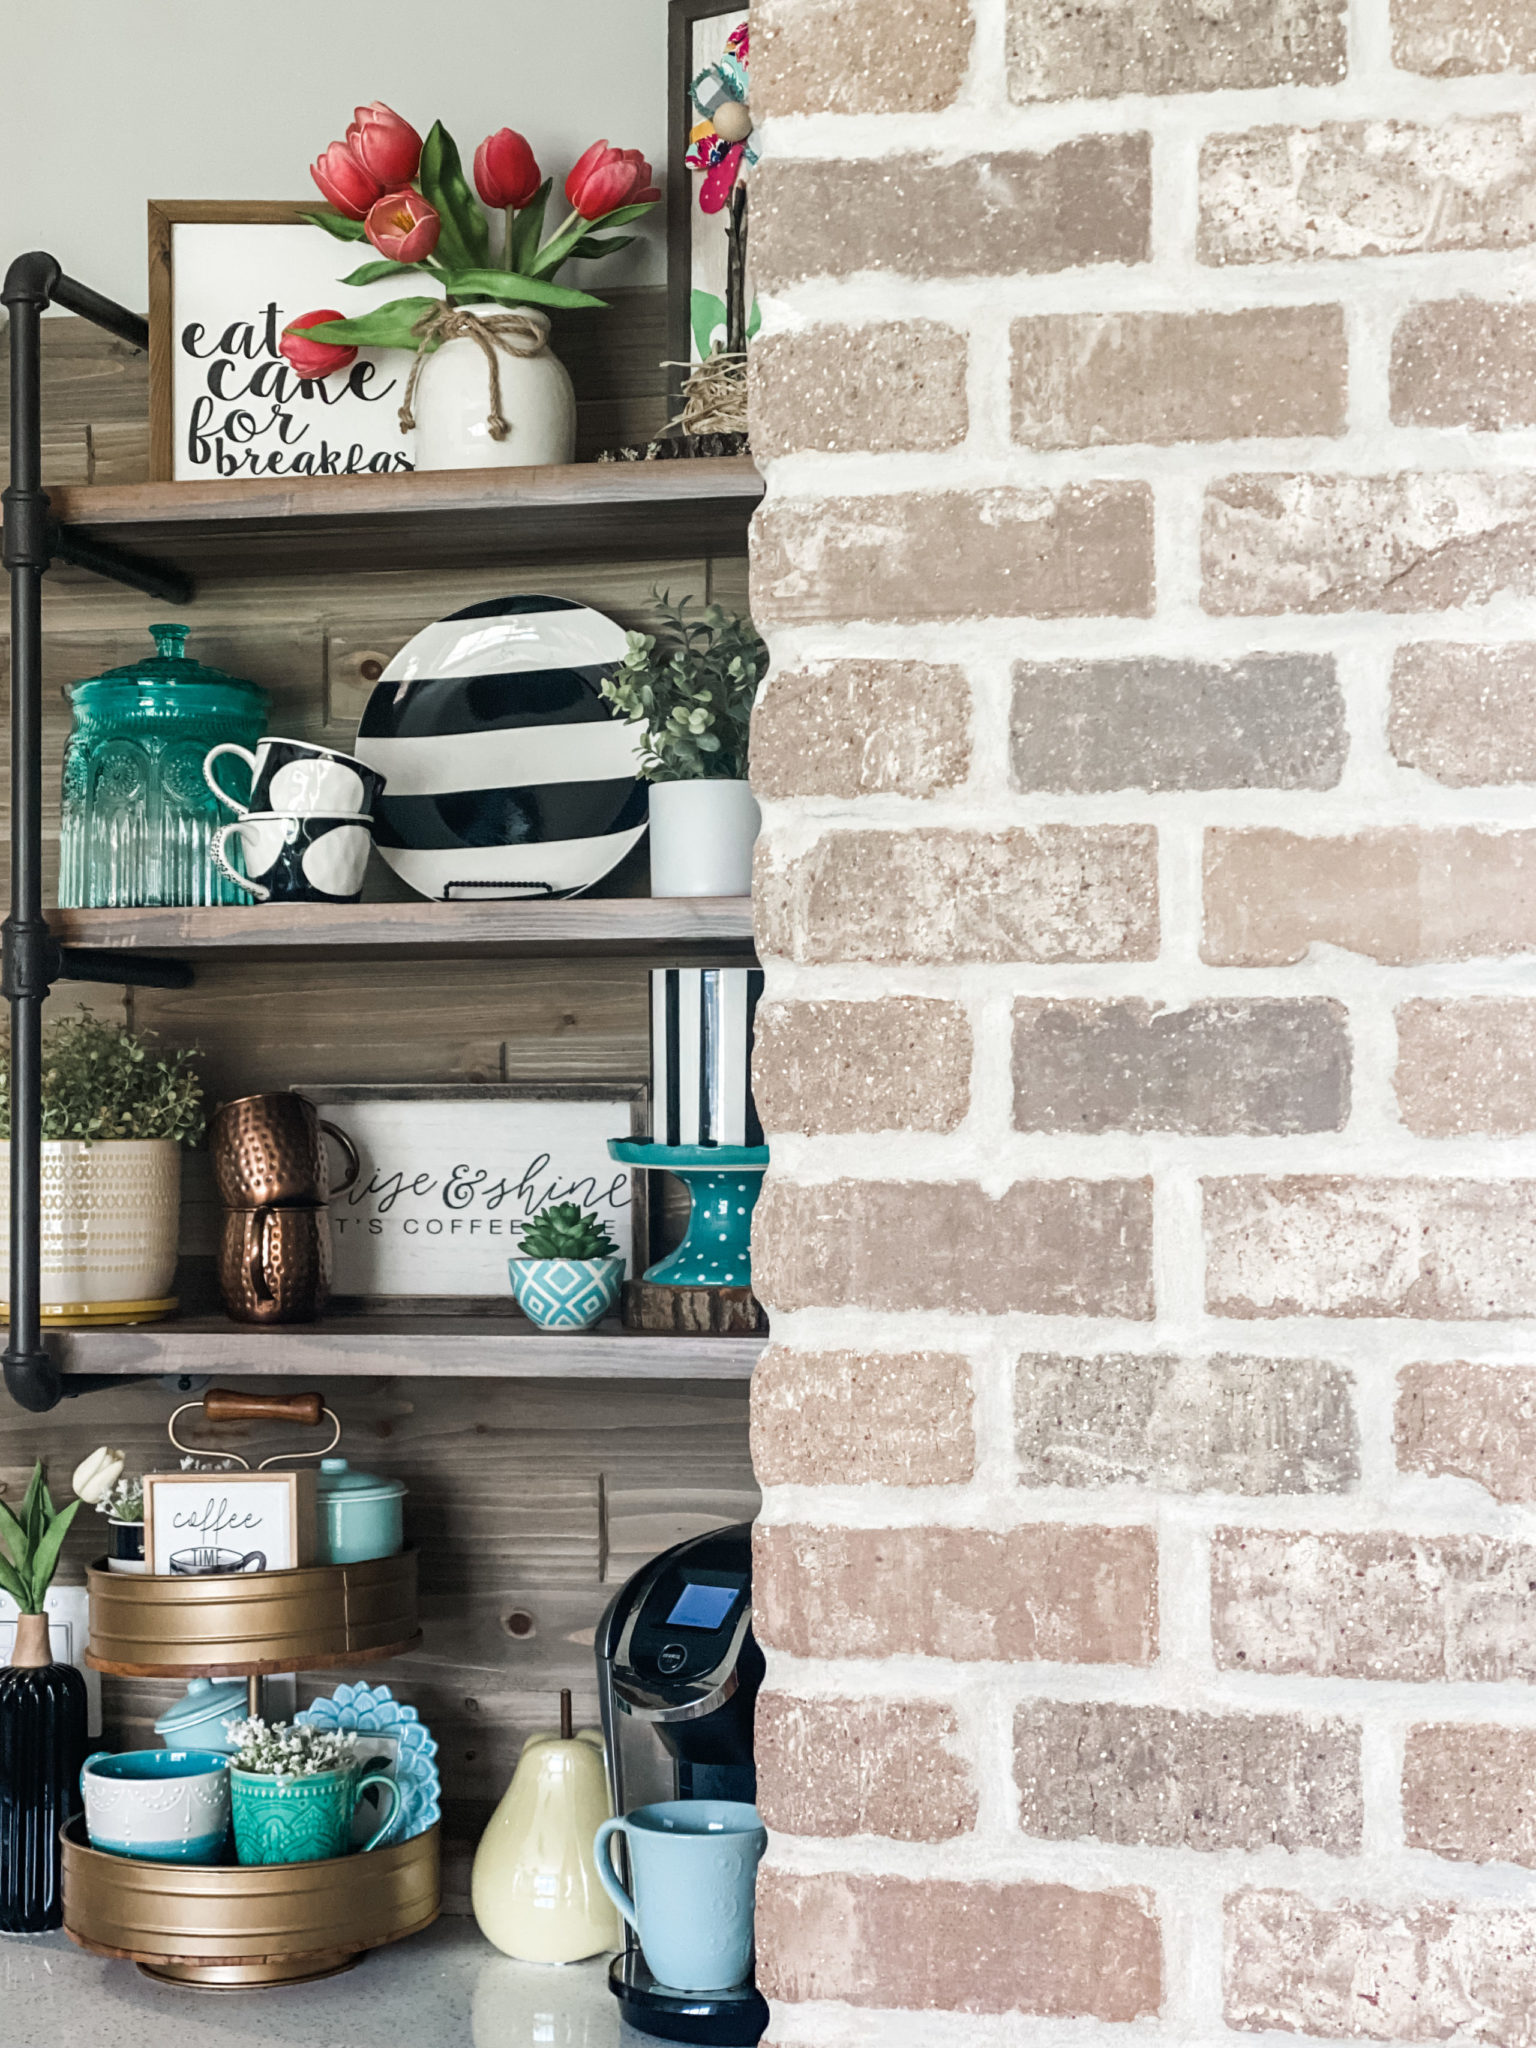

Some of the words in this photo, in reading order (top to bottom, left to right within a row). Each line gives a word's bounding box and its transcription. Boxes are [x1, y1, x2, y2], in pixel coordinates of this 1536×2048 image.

[182, 302, 284, 358] eat
[188, 396, 310, 464] for
[215, 437, 415, 476] breakfas
[335, 1219, 383, 1235] T'S
[403, 1219, 523, 1235] COFFEE
[173, 1498, 263, 1532] coffee
[191, 1548, 222, 1567] TIME
